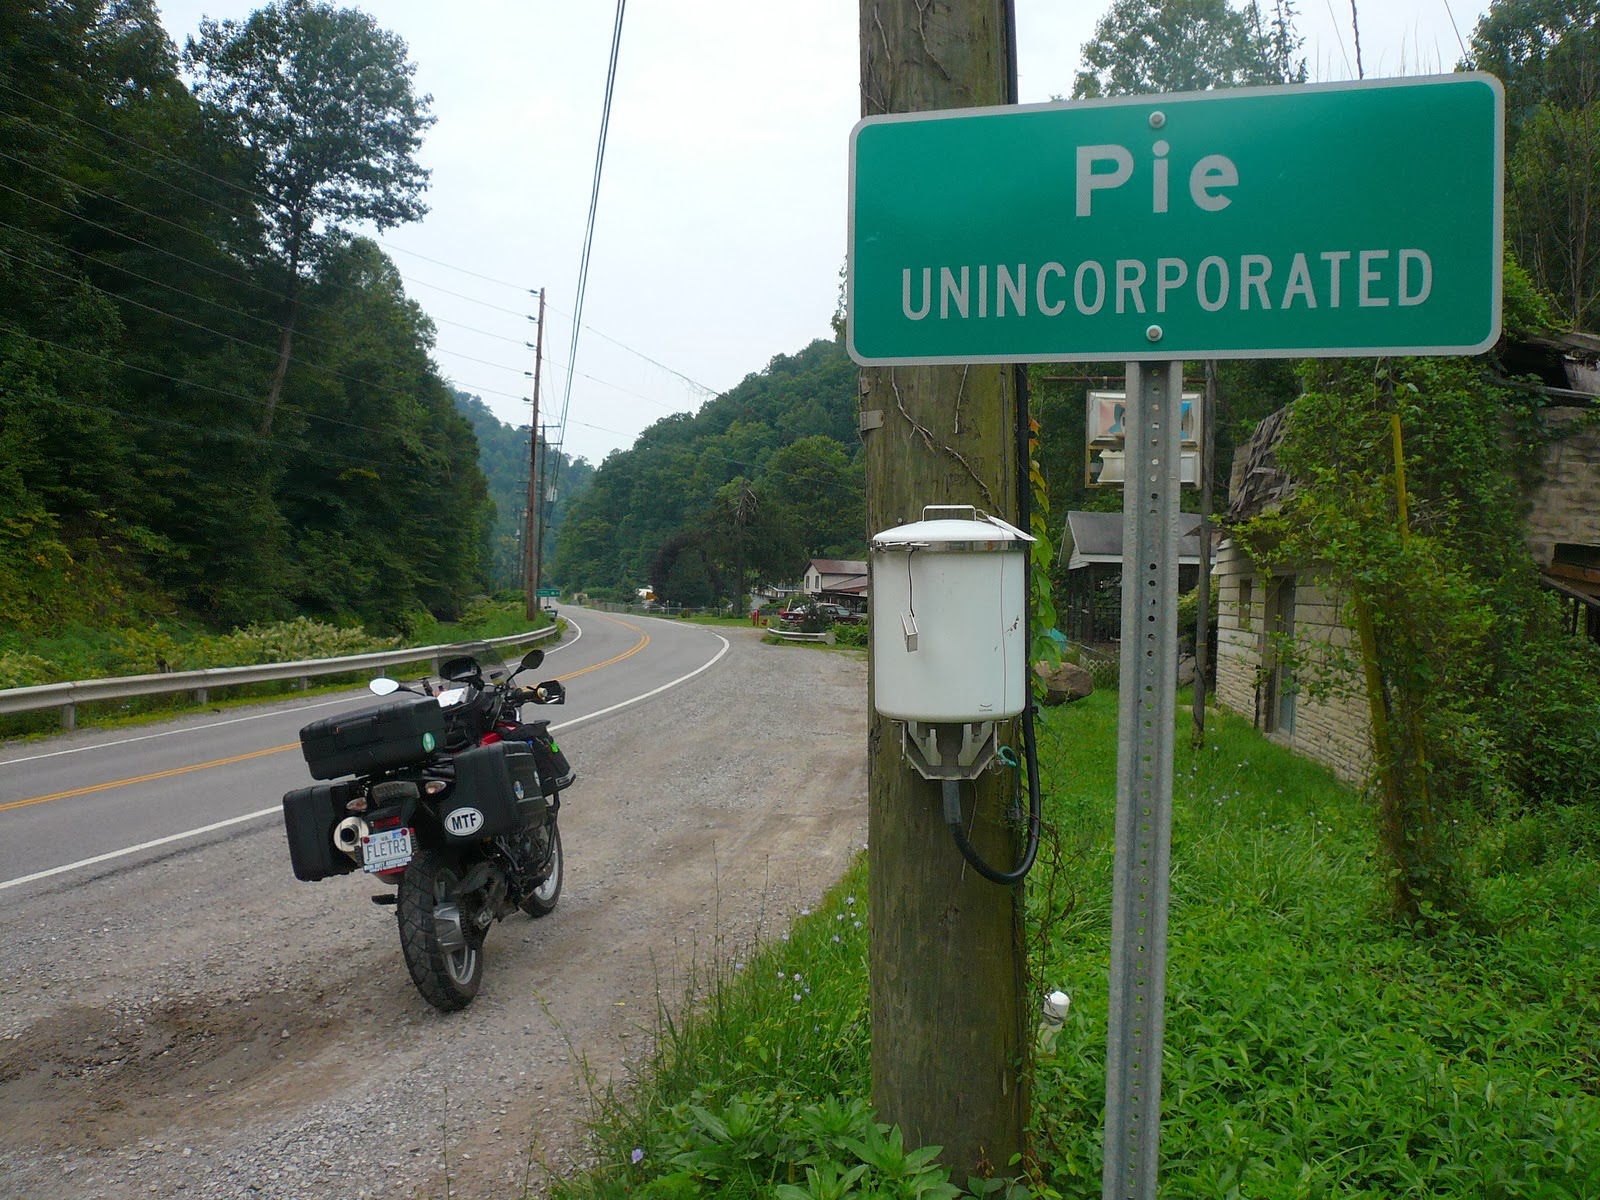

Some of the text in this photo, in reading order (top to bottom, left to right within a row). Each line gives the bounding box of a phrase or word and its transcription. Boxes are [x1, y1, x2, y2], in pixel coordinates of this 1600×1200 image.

[1075, 140, 1239, 217] Pie
[902, 248, 1433, 321] UNINCORPORATED
[452, 813, 477, 831] MTF
[367, 838, 407, 858] FLETR3
